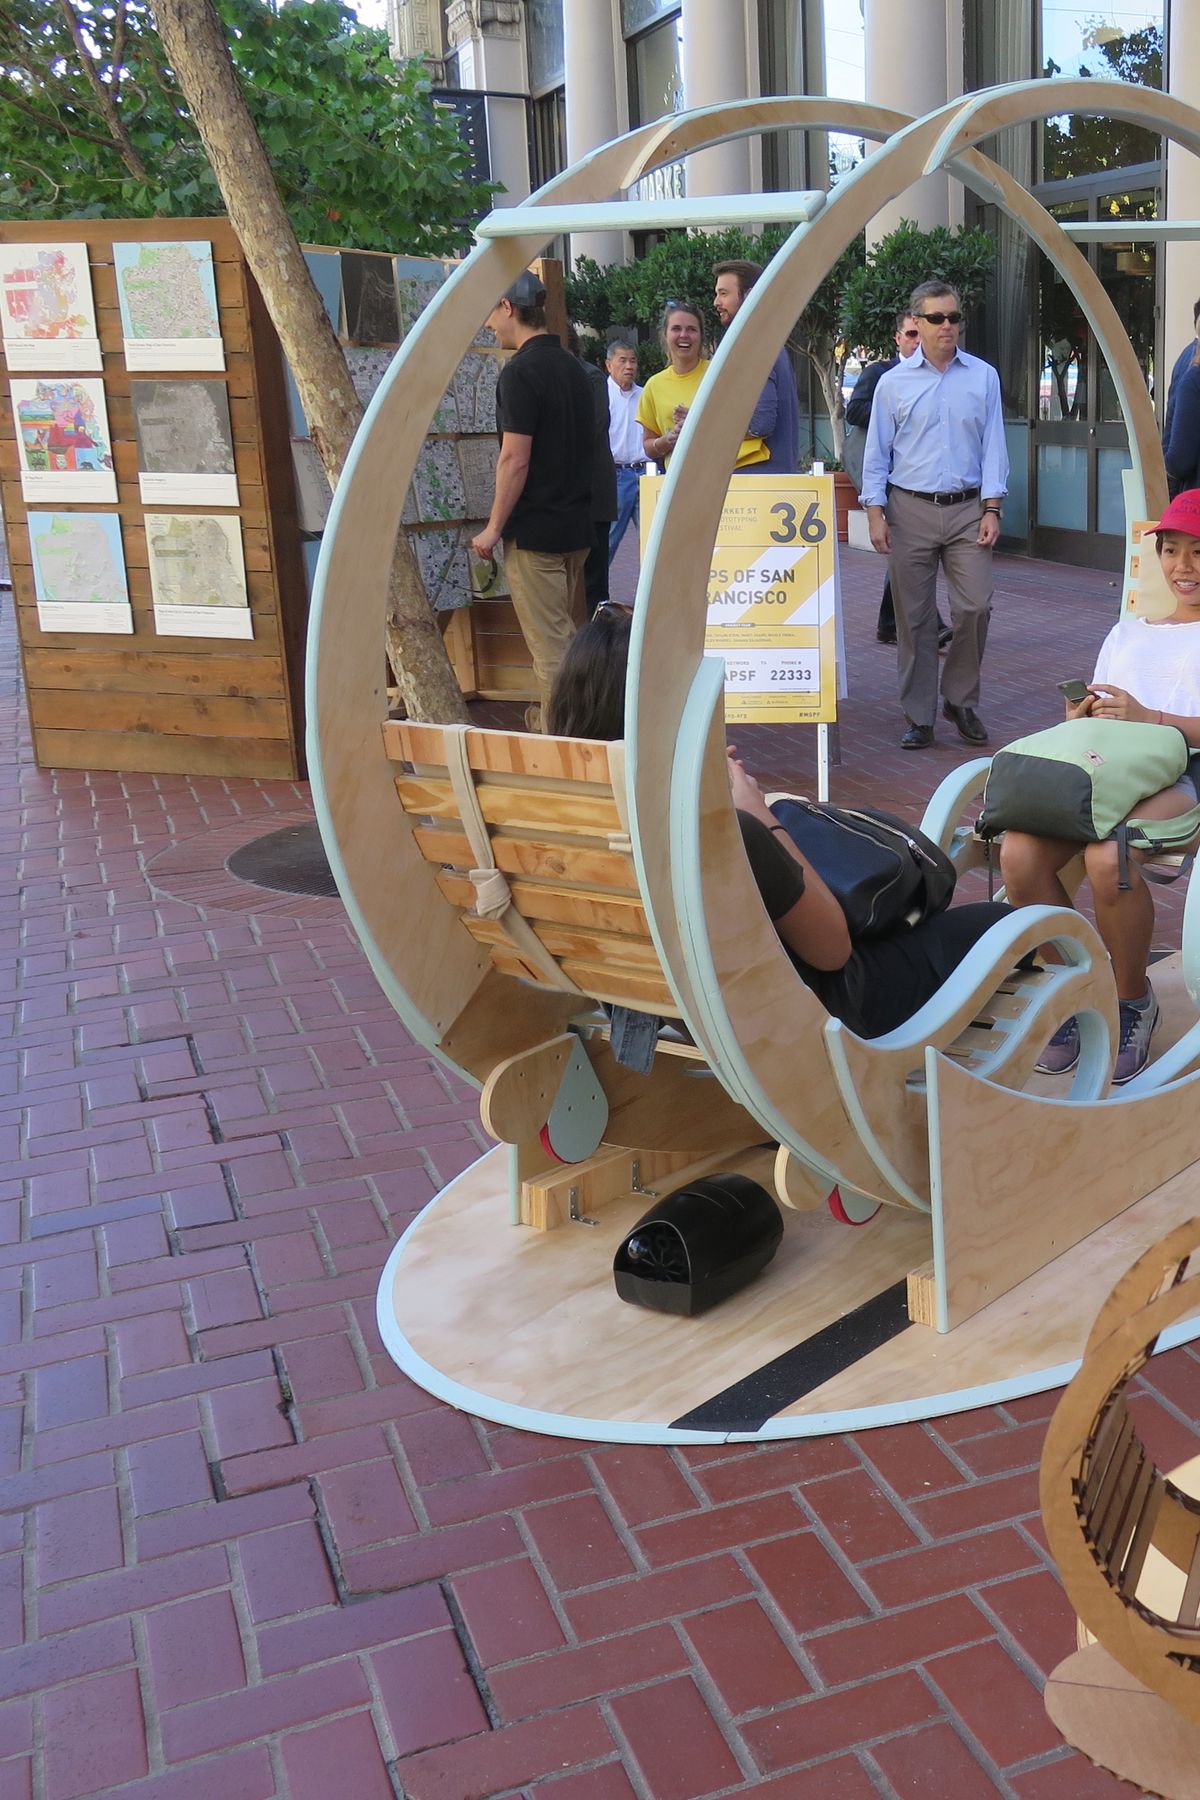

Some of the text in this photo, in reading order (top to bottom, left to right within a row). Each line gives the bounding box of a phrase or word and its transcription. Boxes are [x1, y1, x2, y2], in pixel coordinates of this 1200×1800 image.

[640, 163, 687, 200] MARKE
[769, 502, 827, 543] 36
[709, 569, 795, 583] PS OF SAN
[706, 591, 787, 605] RANCISCO
[724, 669, 812, 681] APSF 22333
